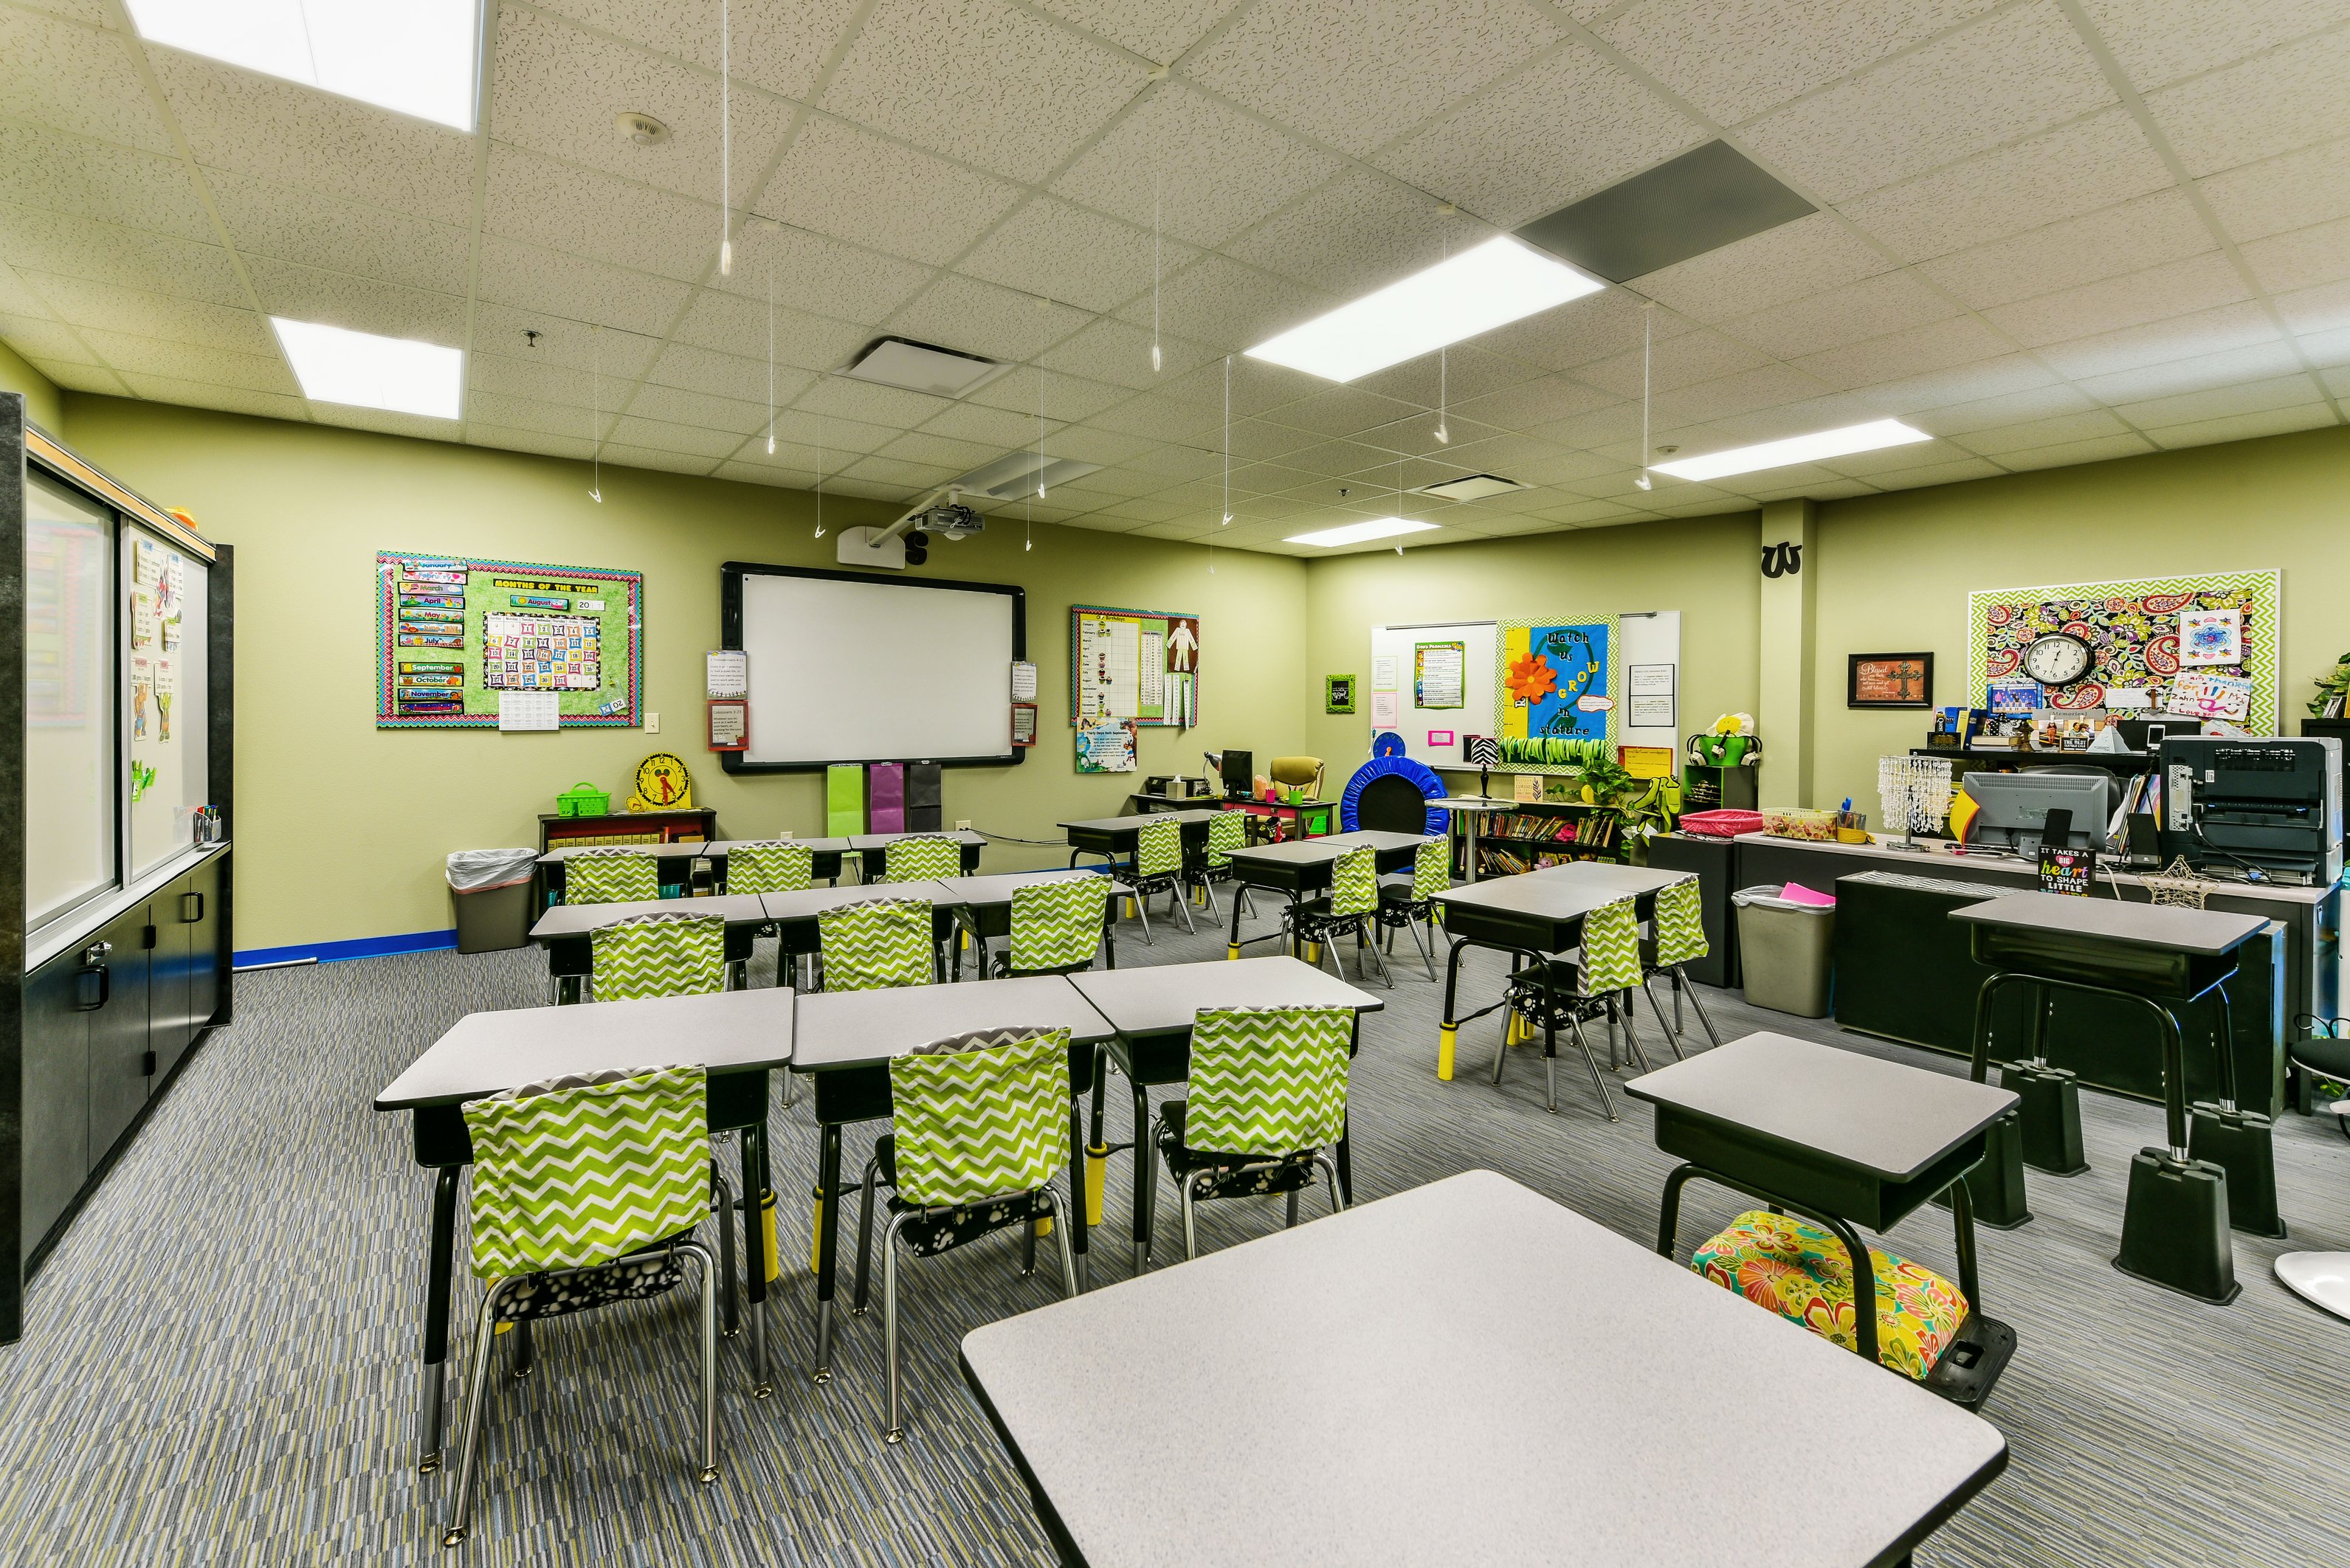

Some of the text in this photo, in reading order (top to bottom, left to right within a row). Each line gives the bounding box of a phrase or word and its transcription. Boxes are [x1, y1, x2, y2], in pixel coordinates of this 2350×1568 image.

[419, 572, 451, 580] February
[495, 580, 535, 589] MONTHS
[528, 599, 551, 607] August
[1547, 632, 1589, 644] Watch
[1559, 652, 1573, 662] us
[1860, 663, 1888, 675] Blessed
[2177, 681, 2198, 691] for
[2171, 692, 2245, 704] Zahn Mrs
[1558, 704, 1570, 717] in
[1540, 724, 1589, 735] stature
[2041, 860, 2088, 878] heart
[2057, 876, 2088, 886] SHAPE
[2048, 882, 2082, 892] LITTLE
